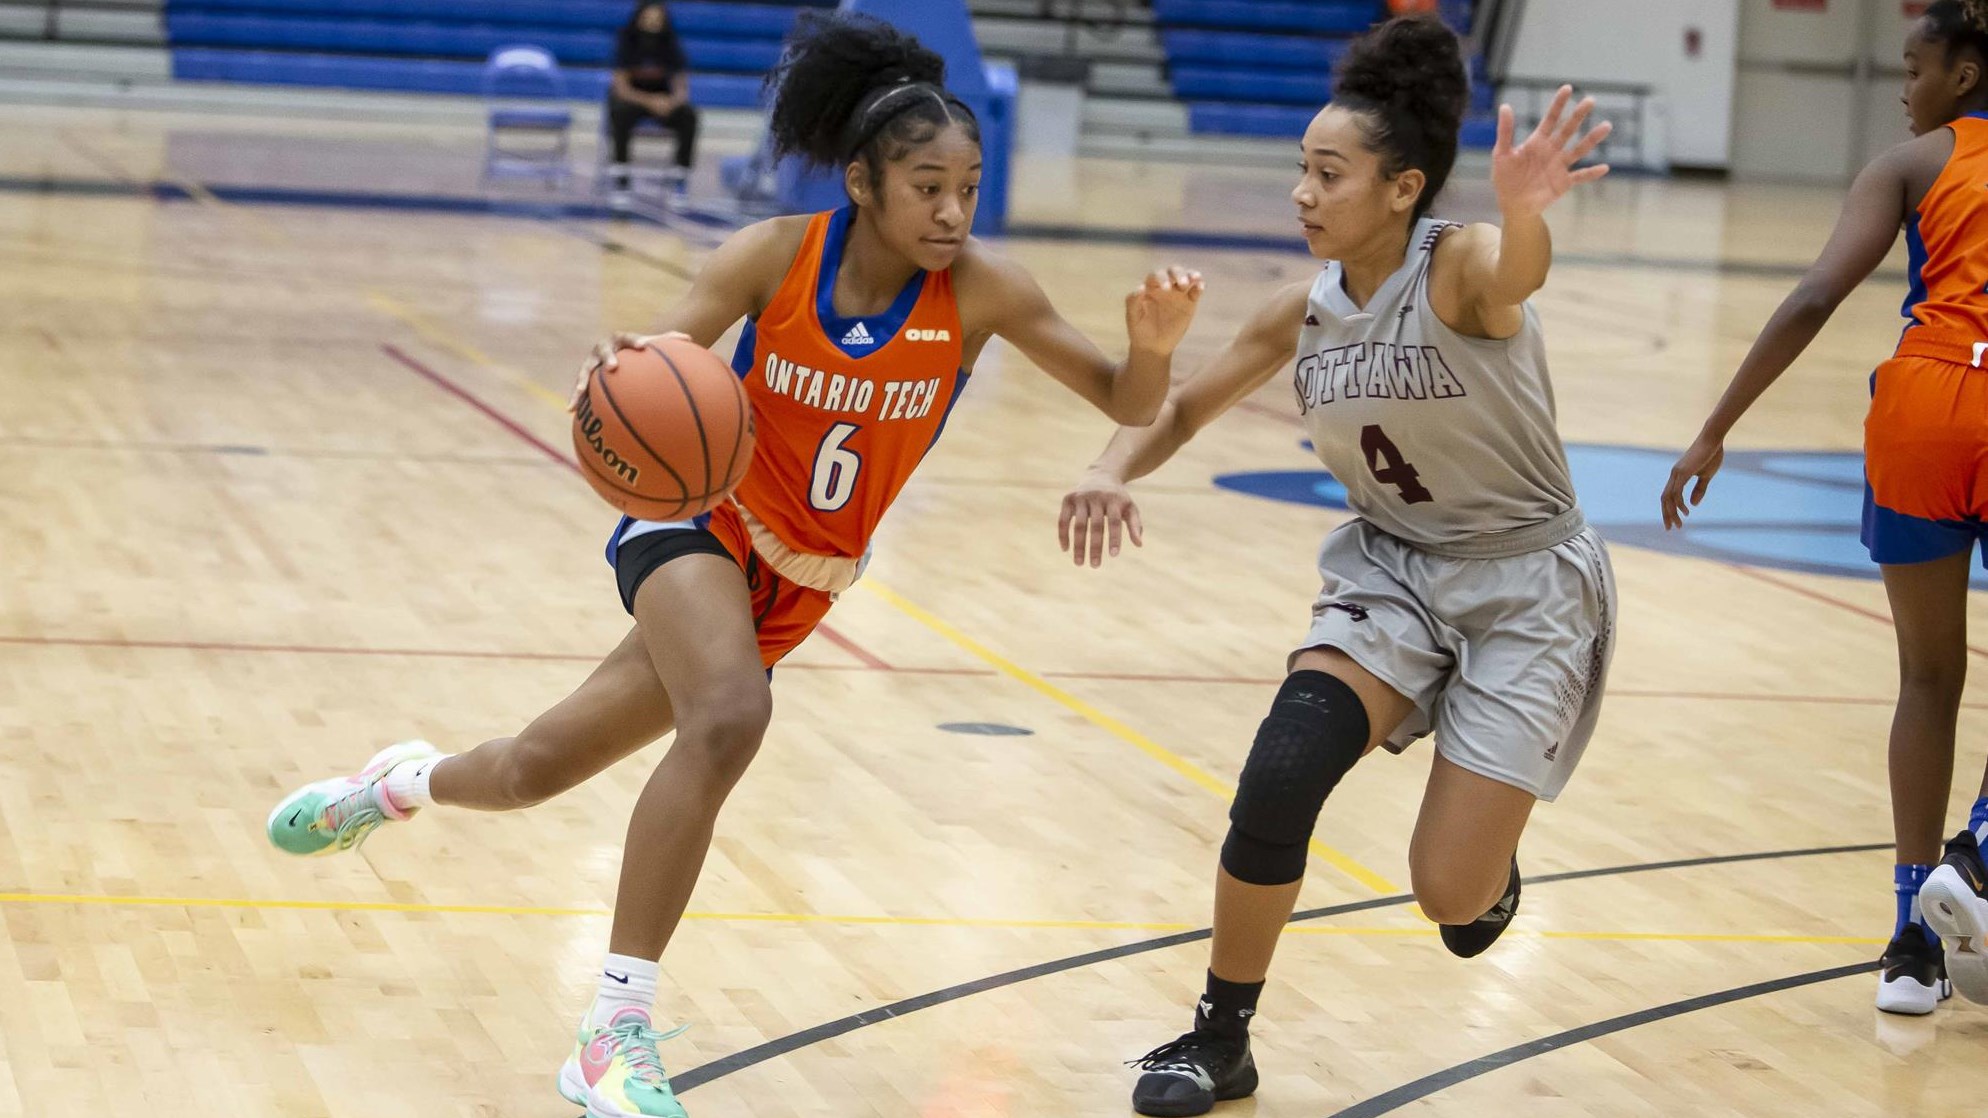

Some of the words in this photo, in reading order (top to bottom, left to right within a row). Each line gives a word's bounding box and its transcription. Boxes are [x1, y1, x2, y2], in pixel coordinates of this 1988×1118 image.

[841, 336, 875, 345] adidas
[905, 328, 951, 342] OUA
[764, 351, 876, 414] ONTARIO
[877, 376, 941, 422] TECH
[807, 420, 862, 512] 6
[1359, 423, 1435, 505] 4
